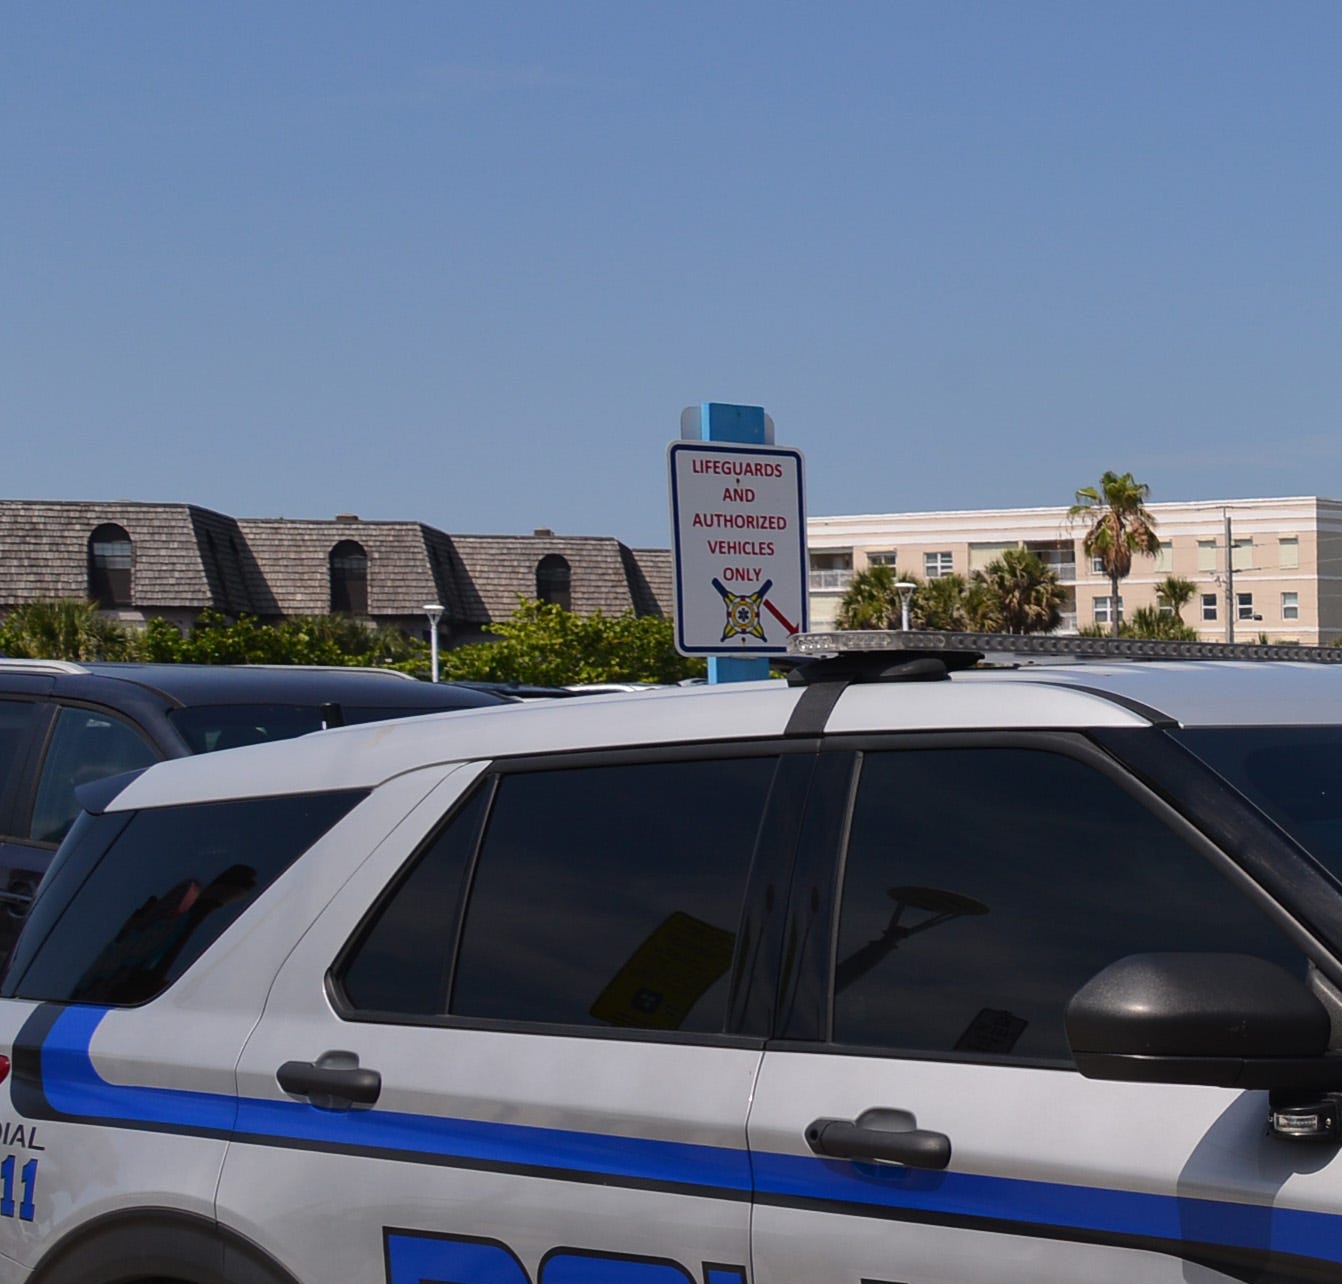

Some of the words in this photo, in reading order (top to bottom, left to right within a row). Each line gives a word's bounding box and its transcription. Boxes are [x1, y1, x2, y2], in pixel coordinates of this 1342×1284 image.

[691, 459, 783, 478] LIFEGUARDS
[722, 487, 756, 503] AND
[692, 512, 787, 530] AUTHORIZED
[707, 539, 775, 556] VEHICLES
[722, 566, 763, 582] ONLY
[0, 1122, 45, 1151] IAL
